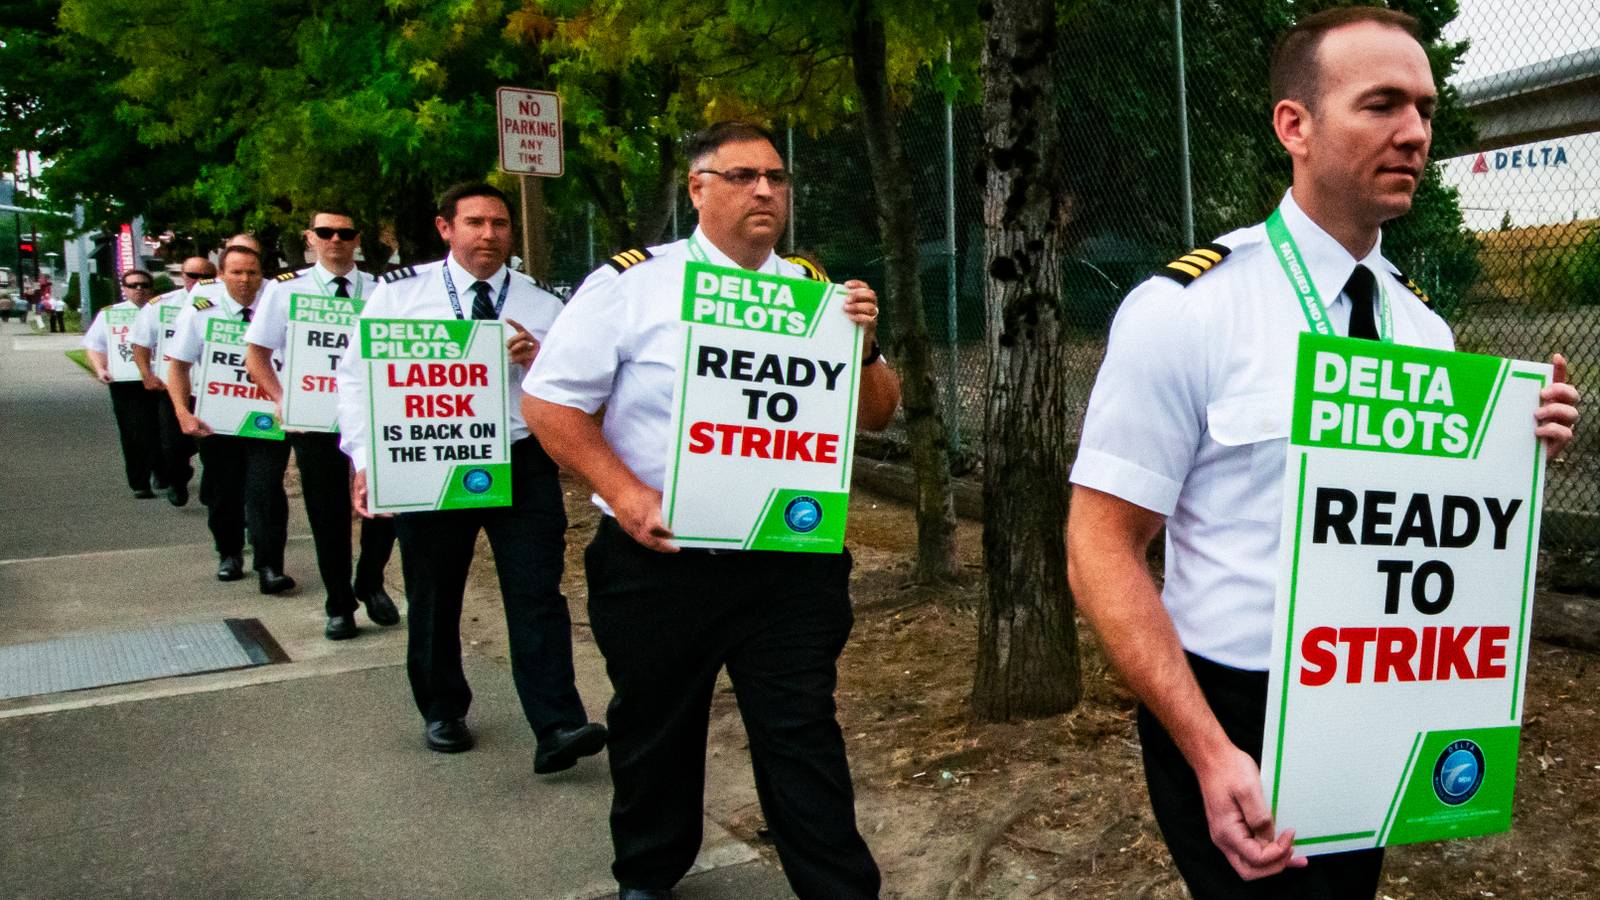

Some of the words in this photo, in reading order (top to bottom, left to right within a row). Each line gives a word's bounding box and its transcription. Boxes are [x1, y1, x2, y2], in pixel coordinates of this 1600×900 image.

[518, 101, 541, 117] NO
[504, 118, 556, 138] PARKING
[520, 139, 543, 150] ANY
[518, 153, 544, 165] TIME
[1495, 146, 1567, 170] DELTA
[695, 271, 795, 308] DELTA
[1280, 241, 1311, 294] FATIGUED
[1303, 294, 1322, 321] AND
[296, 297, 354, 313] DELTA
[693, 297, 806, 335] PILOTS
[307, 330, 349, 349] REA
[369, 322, 450, 340] DELTA
[370, 341, 461, 358] PILOTS
[328, 354, 342, 371] T
[697, 345, 847, 391] READY
[387, 363, 489, 388] LABOR
[1313, 351, 1455, 407] DELTA
[404, 394, 476, 418] RISK
[742, 388, 798, 423] TO
[383, 425, 403, 441] IS
[410, 424, 464, 440] BACK
[469, 423, 496, 438] ON
[1309, 400, 1470, 453] PILOTS
[388, 446, 427, 463] THE
[432, 444, 492, 461] TABLE
[688, 421, 840, 464] STRIKE
[1312, 487, 1524, 550] READY
[1377, 559, 1455, 615] TO
[1299, 626, 1511, 686] STRIKE
[1448, 742, 1476, 753] DELTA
